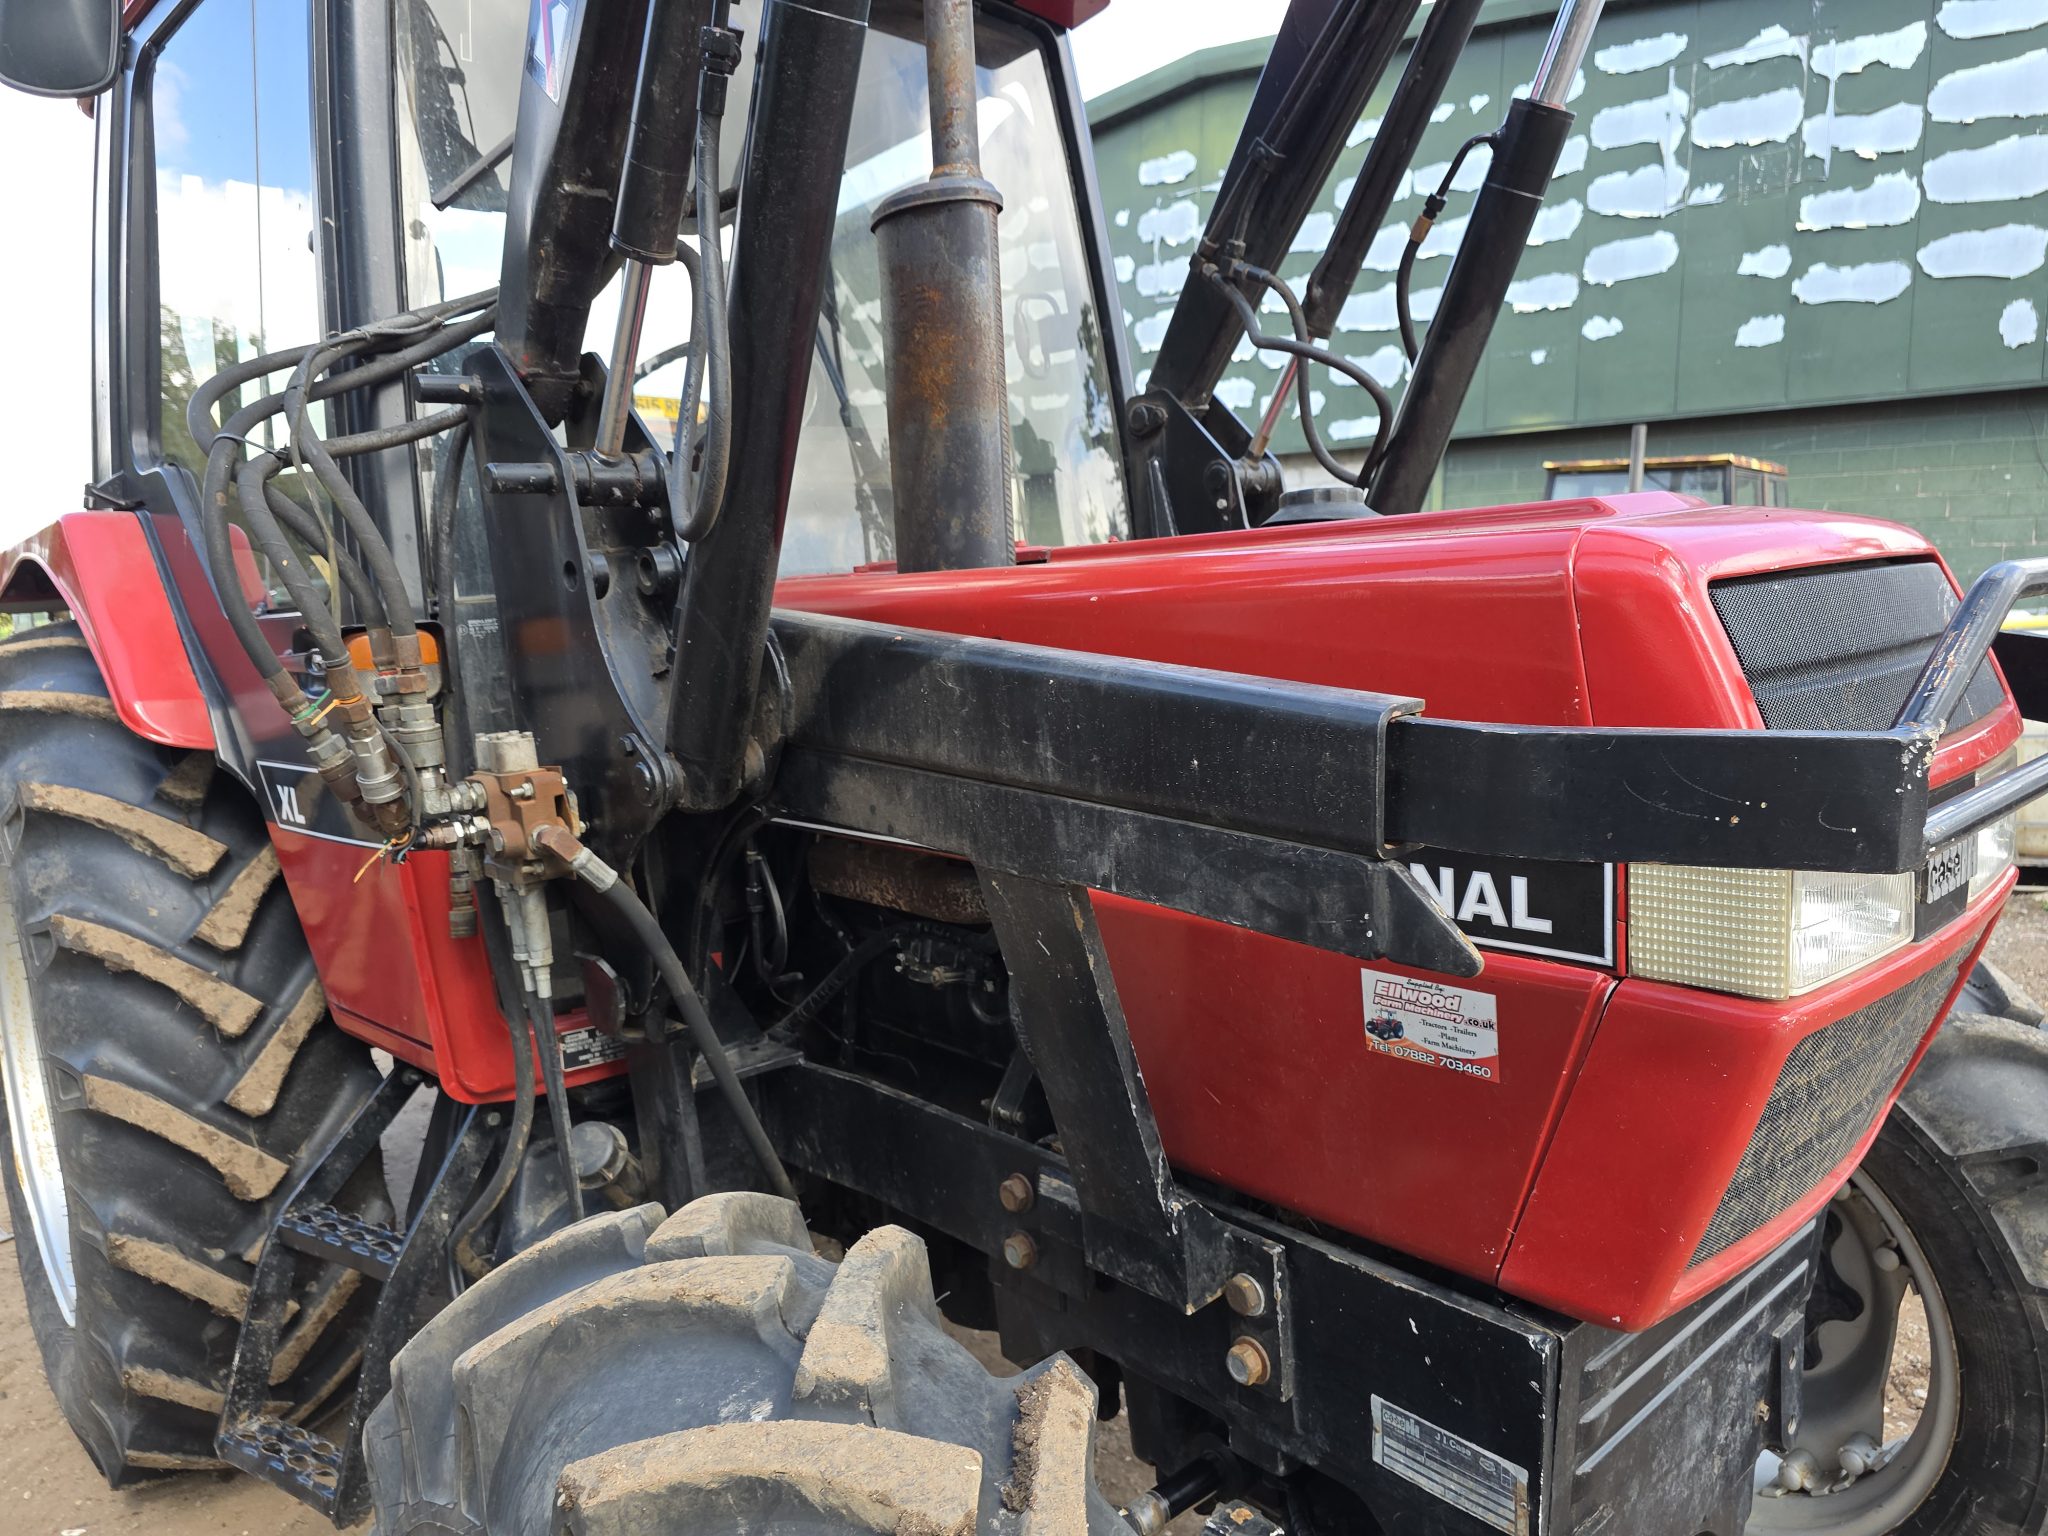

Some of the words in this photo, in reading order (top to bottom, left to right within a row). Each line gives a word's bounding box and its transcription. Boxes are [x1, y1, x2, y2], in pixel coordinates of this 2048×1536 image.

[276, 784, 306, 825] XL
[1373, 979, 1462, 1012] Ellwood
[1373, 995, 1403, 1010] Farm
[1441, 1041, 1477, 1057] Machinery
[1394, 1045, 1435, 1064] 07882
[1438, 1056, 1492, 1079] 703460
[1449, 1439, 1472, 1457] Case
